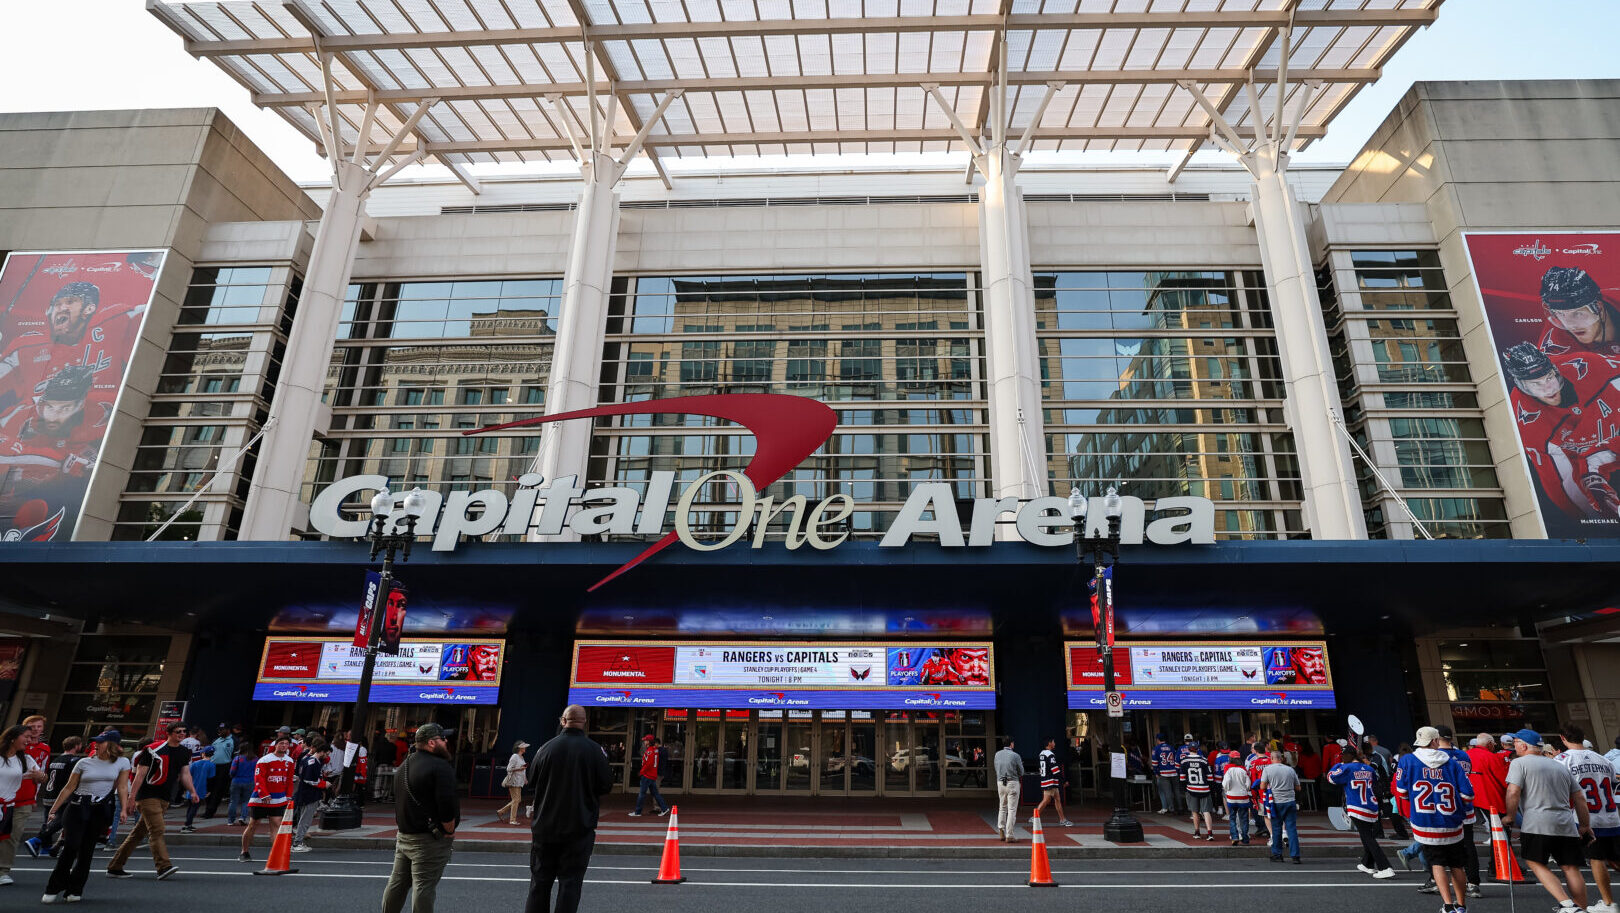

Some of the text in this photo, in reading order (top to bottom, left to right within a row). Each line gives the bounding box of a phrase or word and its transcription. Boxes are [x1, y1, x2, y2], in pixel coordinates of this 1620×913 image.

[91, 327, 104, 342] C
[1597, 398, 1612, 418] A
[309, 469, 1216, 552] Capital One Arena
[365, 581, 376, 610] CAPS
[722, 651, 772, 663] RANGERS
[786, 651, 839, 663] CAPITALS
[1161, 652, 1193, 662] RANGERS
[1200, 652, 1232, 662] CAPITALS
[758, 676, 783, 684] TONIGHT
[793, 676, 802, 684] PM
[419, 692, 444, 700] Capital
[748, 698, 774, 706] Capital
[904, 698, 930, 706] Capital
[1160, 752, 1174, 766] 34
[1188, 768, 1204, 784] 61
[1422, 768, 1444, 780] FOX
[1571, 764, 1611, 776] SHESTERKIN
[1412, 780, 1456, 816] 23
[1579, 777, 1616, 814] 31
